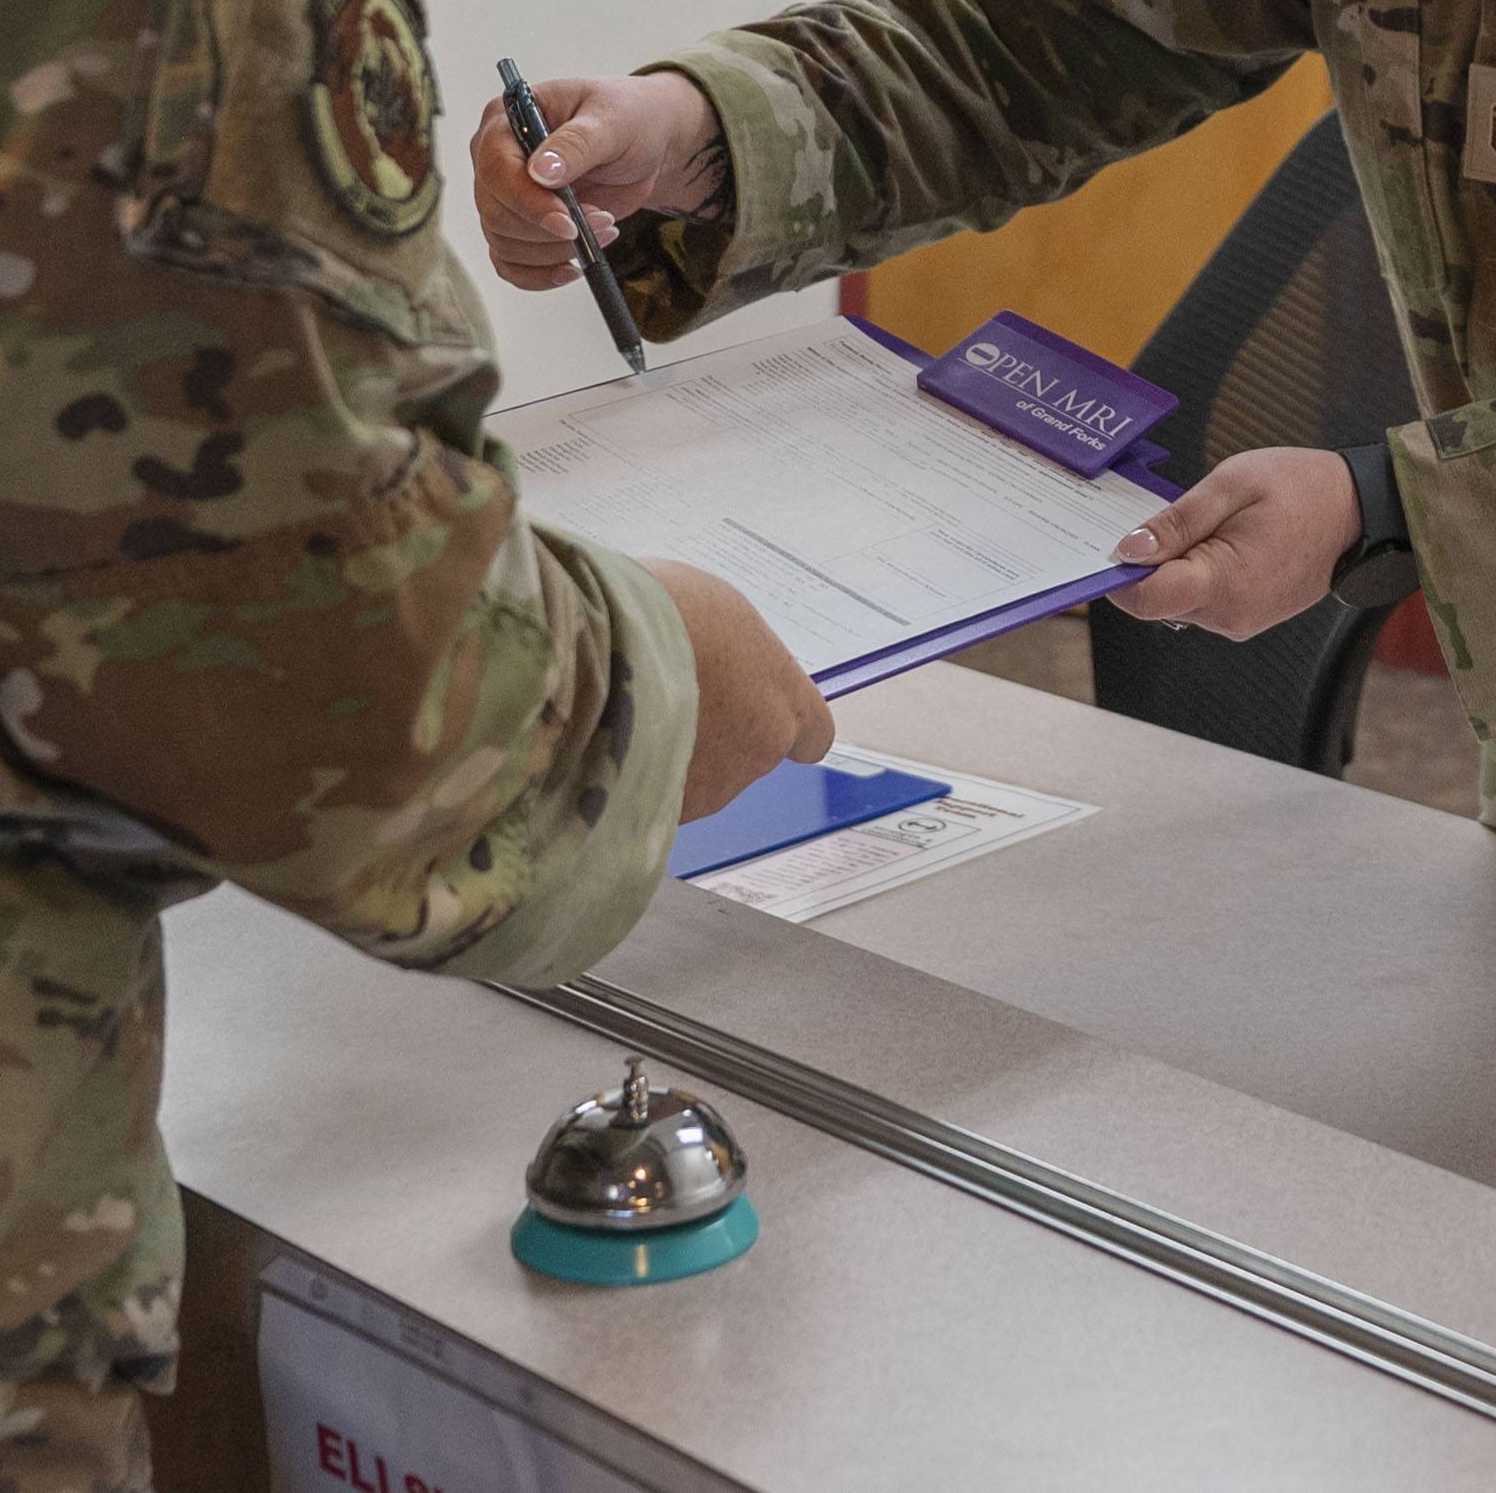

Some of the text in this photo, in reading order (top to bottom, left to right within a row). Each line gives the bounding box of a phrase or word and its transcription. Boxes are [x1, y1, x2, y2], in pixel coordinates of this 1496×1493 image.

[1016, 400, 1106, 451] of Grand Forks
[1053, 389, 1134, 438] MRI
